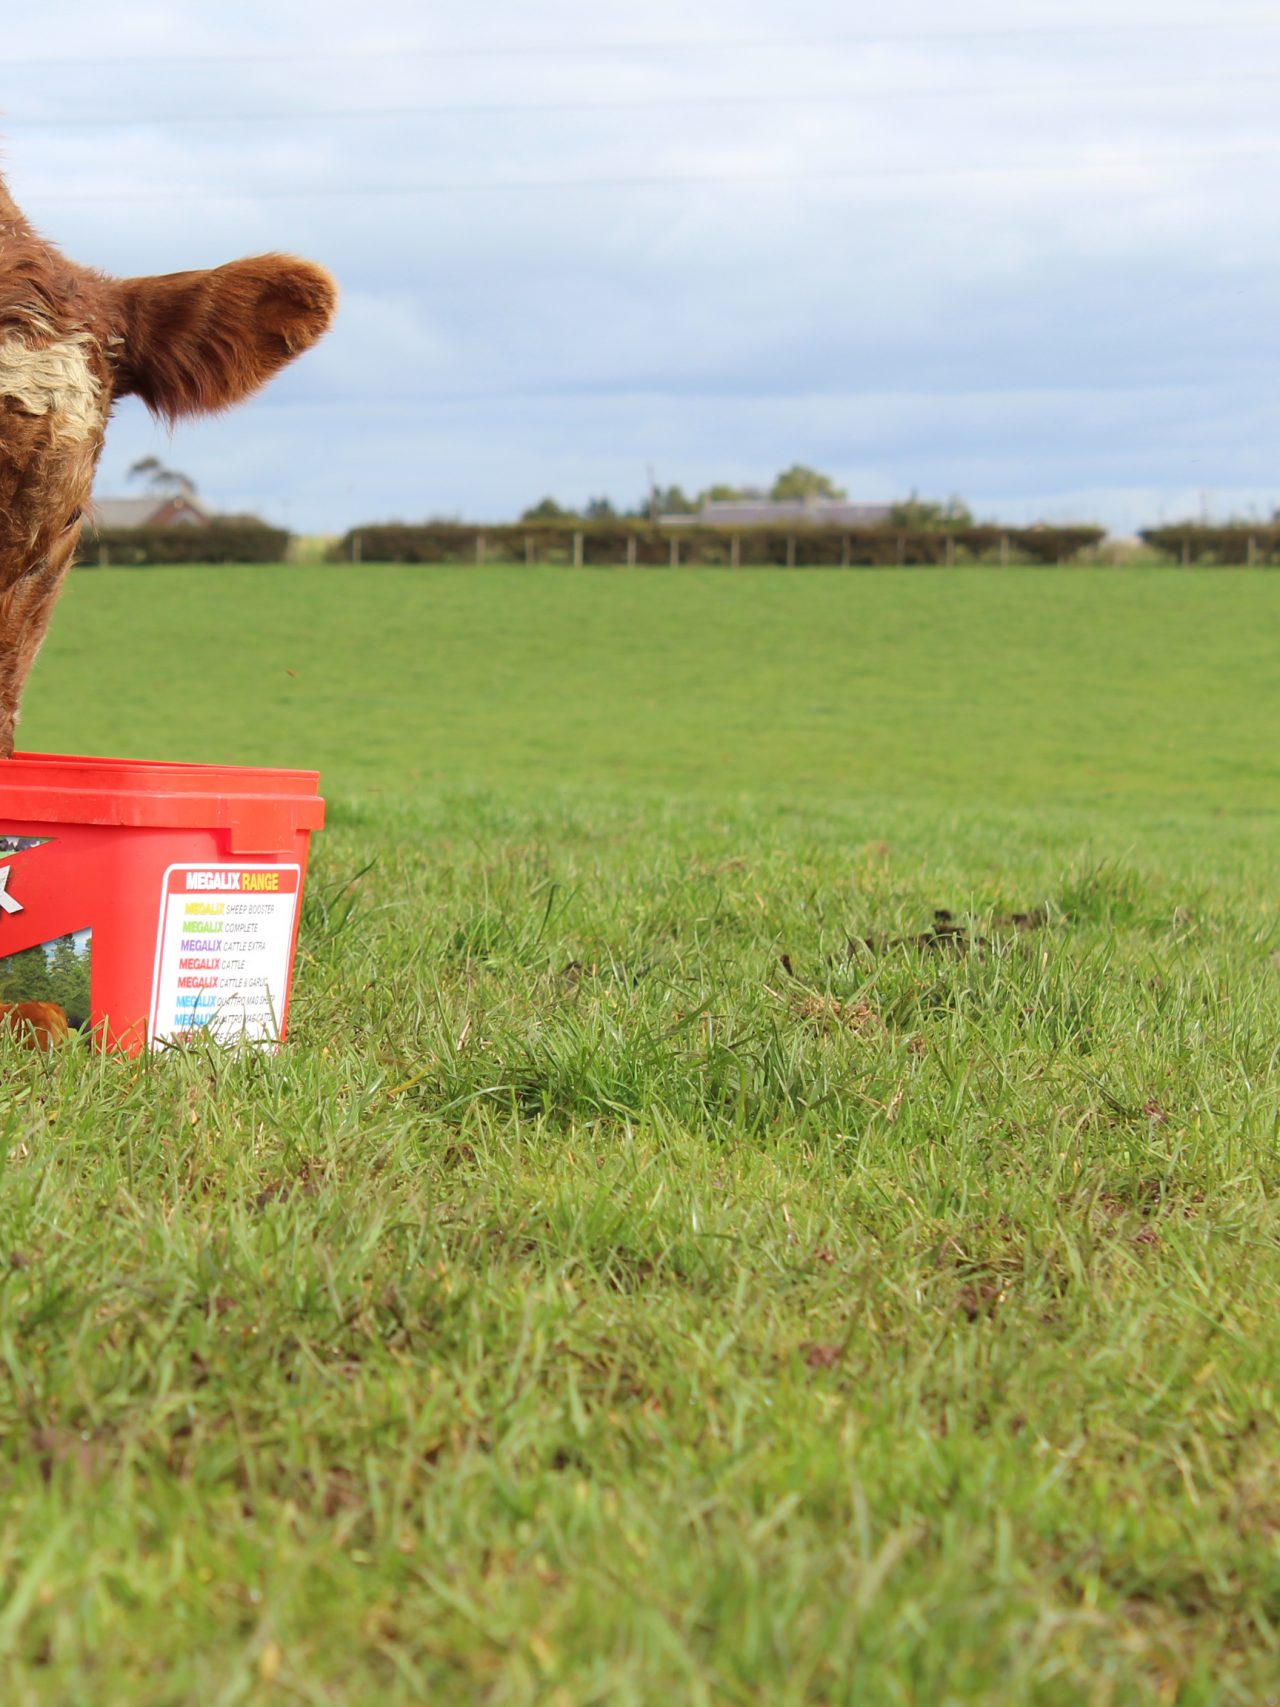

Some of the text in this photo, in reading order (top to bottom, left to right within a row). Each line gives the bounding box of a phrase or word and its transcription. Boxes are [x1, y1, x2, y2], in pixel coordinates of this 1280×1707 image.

[186, 871, 279, 891] MEGALIX RANGE
[184, 902, 275, 915] MEGALIX SHEEP BOOSTER
[182, 921, 259, 934] MEGALIX COMPLETE
[180, 939, 267, 952] MEGALIX CATTLE EXTRA
[179, 958, 246, 970] MEGALIX CATTLE
[177, 976, 219, 989] MEGALIX
[220, 979, 243, 989] CATTLE
[175, 995, 217, 1008] MEGALIX
